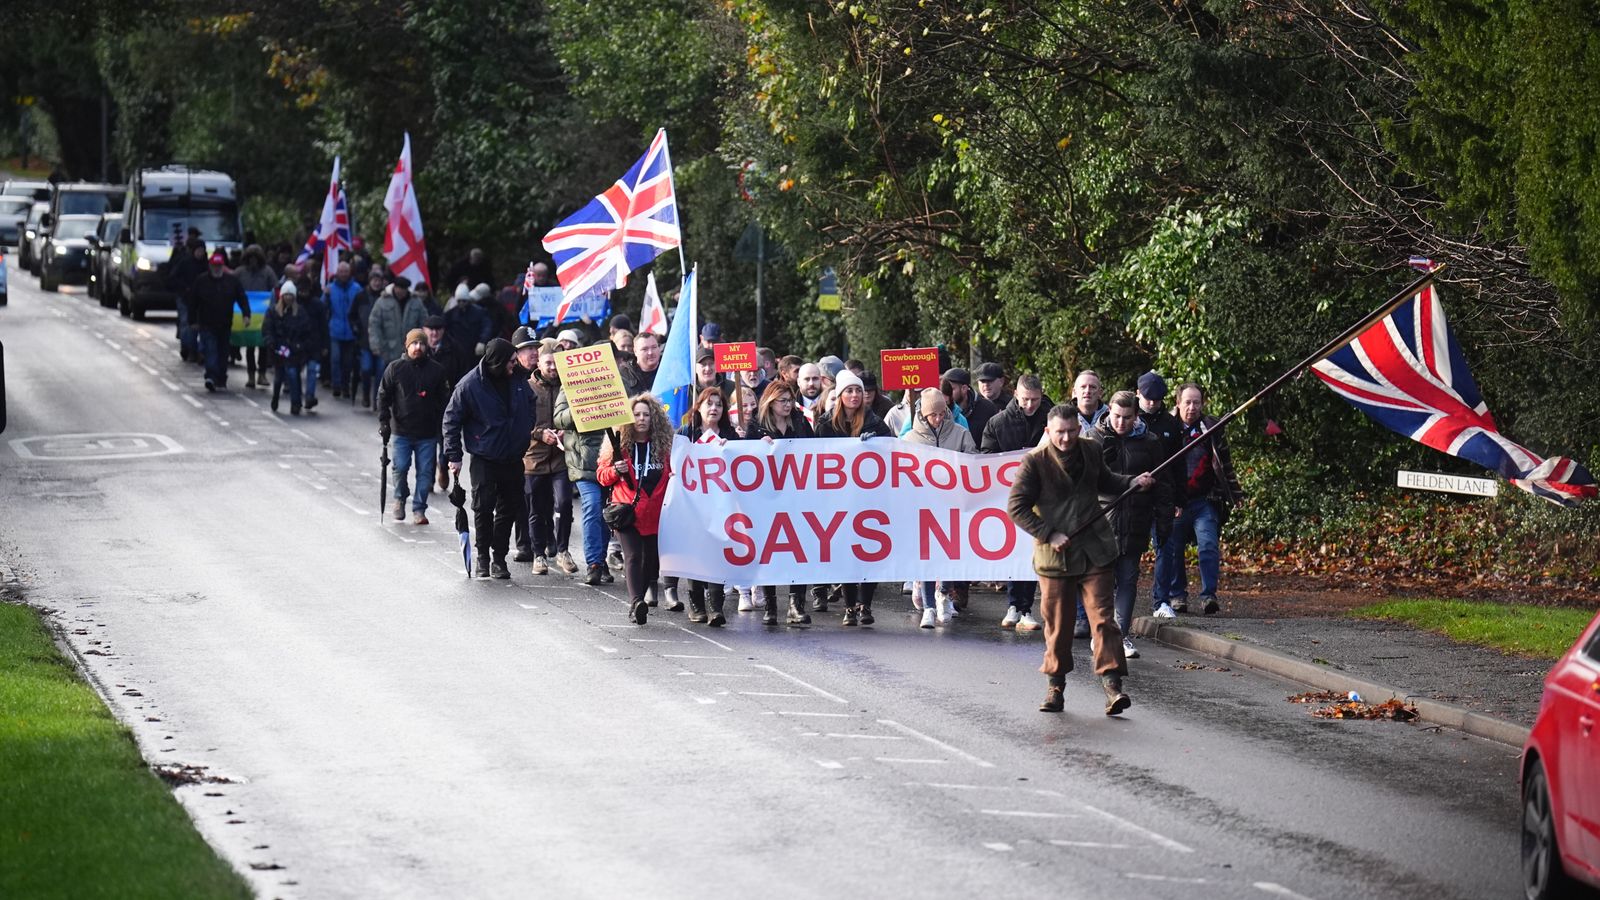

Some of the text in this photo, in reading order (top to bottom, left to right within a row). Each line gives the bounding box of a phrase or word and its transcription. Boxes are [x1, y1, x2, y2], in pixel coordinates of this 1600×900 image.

[565, 350, 602, 365] STOP
[883, 352, 936, 361] Crowborough
[580, 366, 610, 376] ILLEGAL
[720, 362, 752, 370] MATTERS
[901, 364, 919, 372] says
[567, 374, 615, 387] IMMIGRANTS
[902, 374, 920, 386] NO
[576, 385, 602, 394] COMING
[576, 404, 608, 415] PROTECT
[580, 410, 627, 423] COMMUNITY!
[681, 451, 1022, 494] CROWBOROU
[1406, 473, 1489, 493] FIELDEN LANE
[723, 507, 1017, 566] SAYS NO
